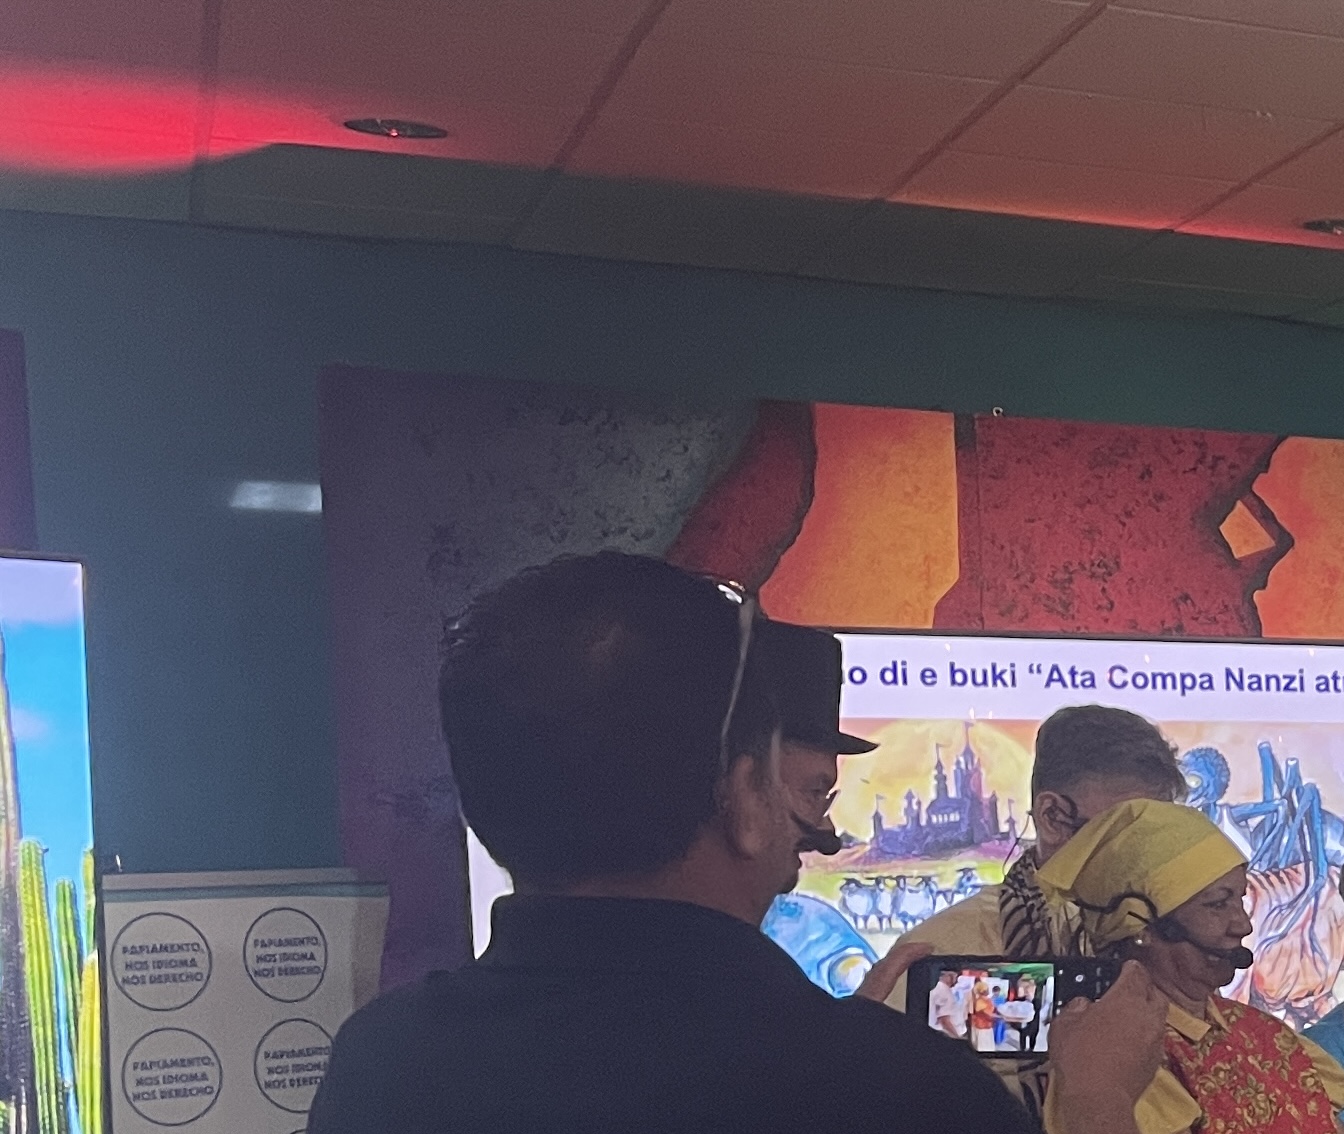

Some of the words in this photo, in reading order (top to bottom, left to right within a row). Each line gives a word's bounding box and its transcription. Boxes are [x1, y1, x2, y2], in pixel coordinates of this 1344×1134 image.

[842, 664, 868, 686] o
[879, 660, 908, 687] di
[920, 667, 937, 687] e
[949, 661, 1018, 688] buki
[1028, 663, 1097, 689] “Ata
[1107, 664, 1215, 697] Compa
[1224, 667, 1306, 693] Nanzi
